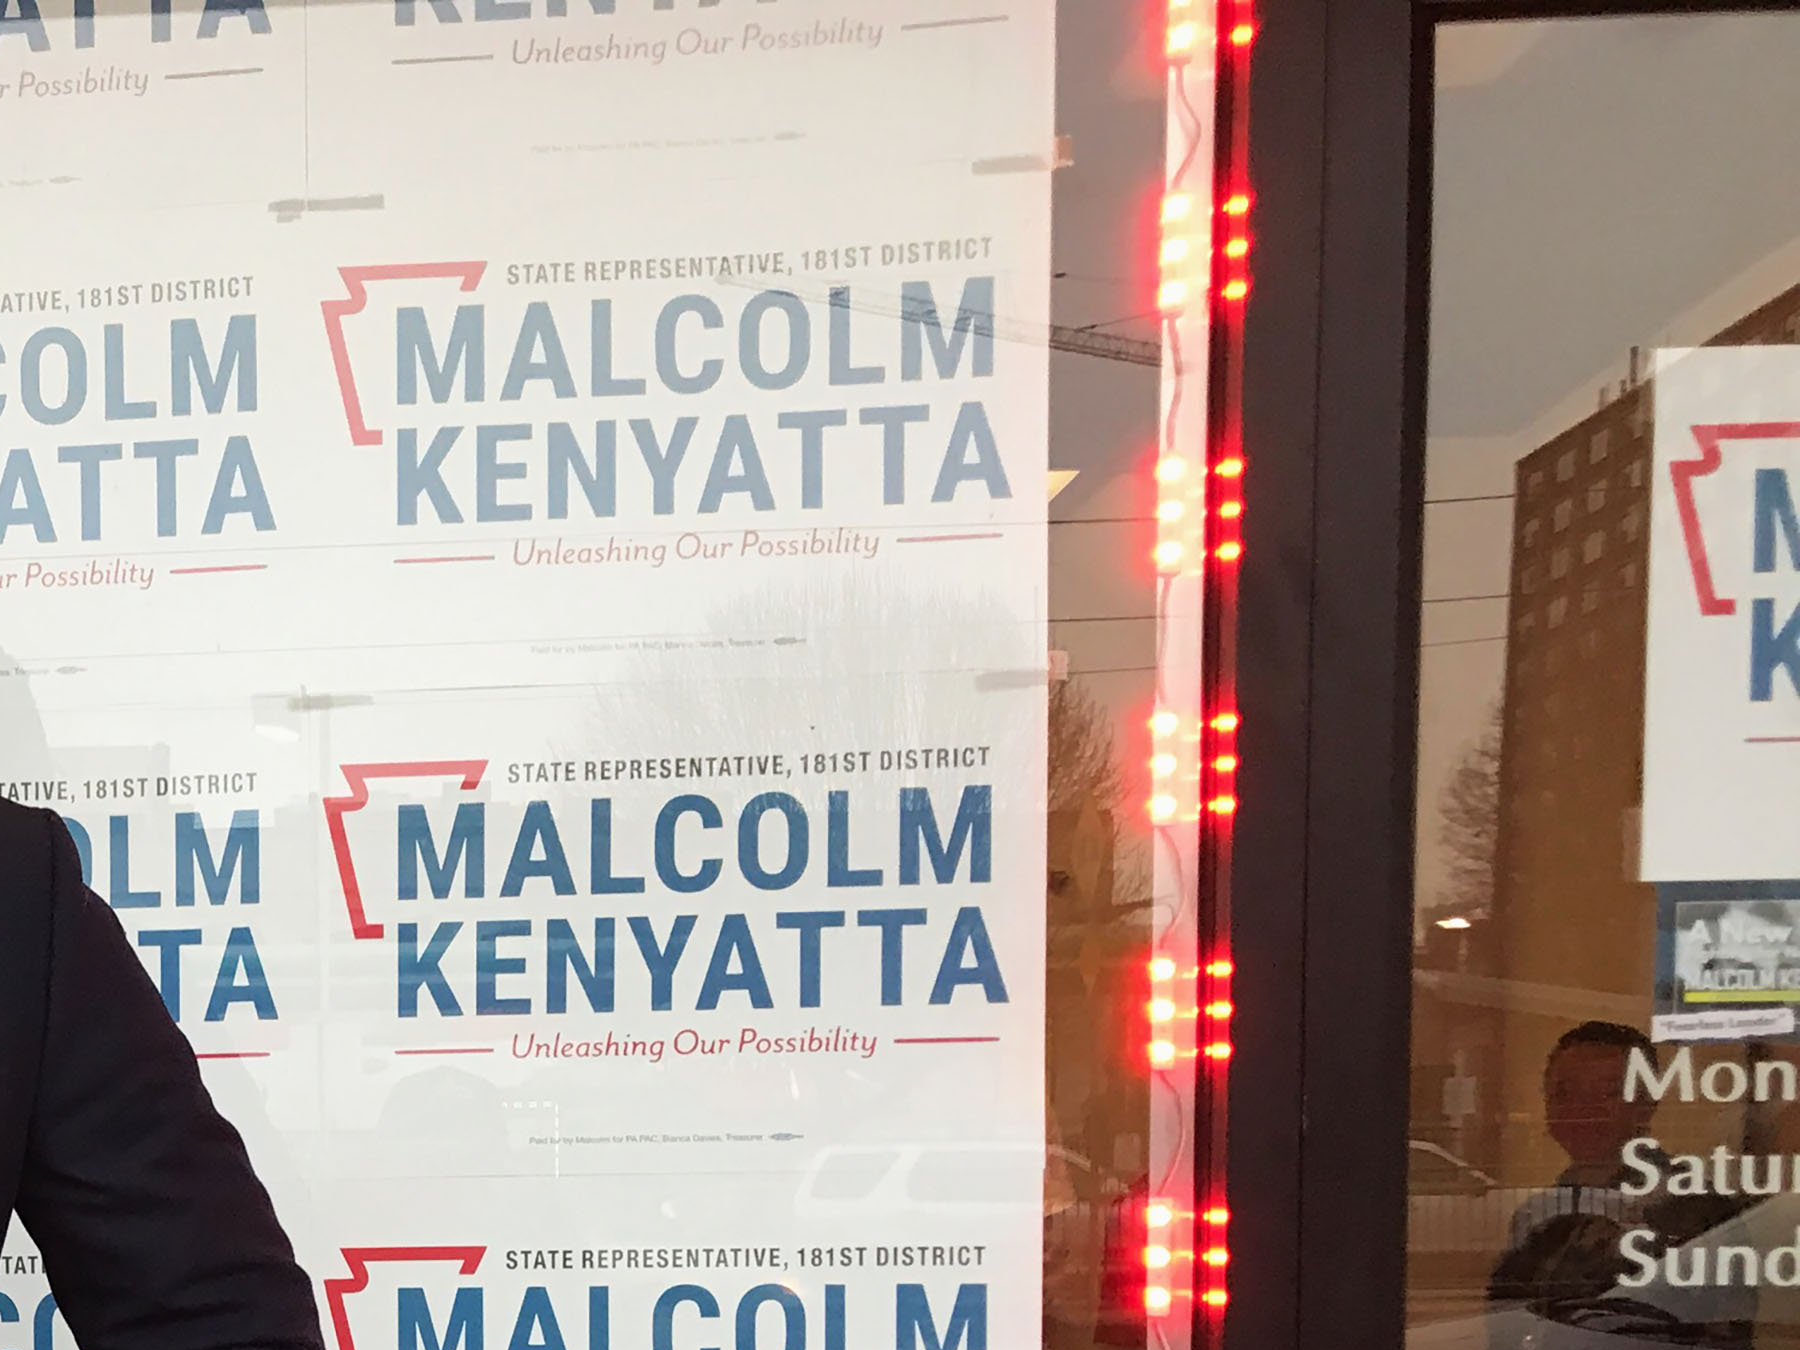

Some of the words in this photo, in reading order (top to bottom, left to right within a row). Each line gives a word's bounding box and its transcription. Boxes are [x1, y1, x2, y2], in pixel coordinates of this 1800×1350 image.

[512, 37, 666, 66] Unleashing
[675, 28, 734, 55] Our
[742, 19, 884, 49] Possibility
[18, 67, 150, 97] Possibility
[506, 262, 577, 286] STATE
[584, 252, 795, 283] REPRESENTATIVE,
[801, 248, 872, 272] 181ST
[880, 237, 994, 267] DISTRICT
[77, 285, 143, 309] 181ST
[151, 276, 255, 304] DISTRICT
[396, 277, 995, 406] MALCOLM
[396, 402, 1013, 526] KENYATTA
[512, 537, 666, 569] Unleashing
[675, 533, 733, 561] Our
[740, 530, 880, 560] Possibility
[25, 560, 155, 590] Possibility
[507, 761, 577, 784] STATE
[584, 754, 794, 782] REPRESENTATIVE,
[800, 751, 872, 776] 181ST
[879, 746, 991, 772] DISTRICT
[83, 777, 149, 800] 181ST
[156, 772, 258, 797] DISTRICT
[398, 785, 993, 900] MALCOLM
[398, 906, 1010, 1019] KENYATTA
[512, 1033, 664, 1064] Unleashing
[673, 1029, 730, 1057] Our
[738, 1027, 878, 1058] Possibility
[1623, 1046, 1796, 1102] Mon
[505, 1249, 574, 1270] STATE
[581, 1247, 789, 1272] REPRESENTATIVE,
[796, 1246, 868, 1268] 181ST
[876, 1245, 987, 1267] DISTRICT
